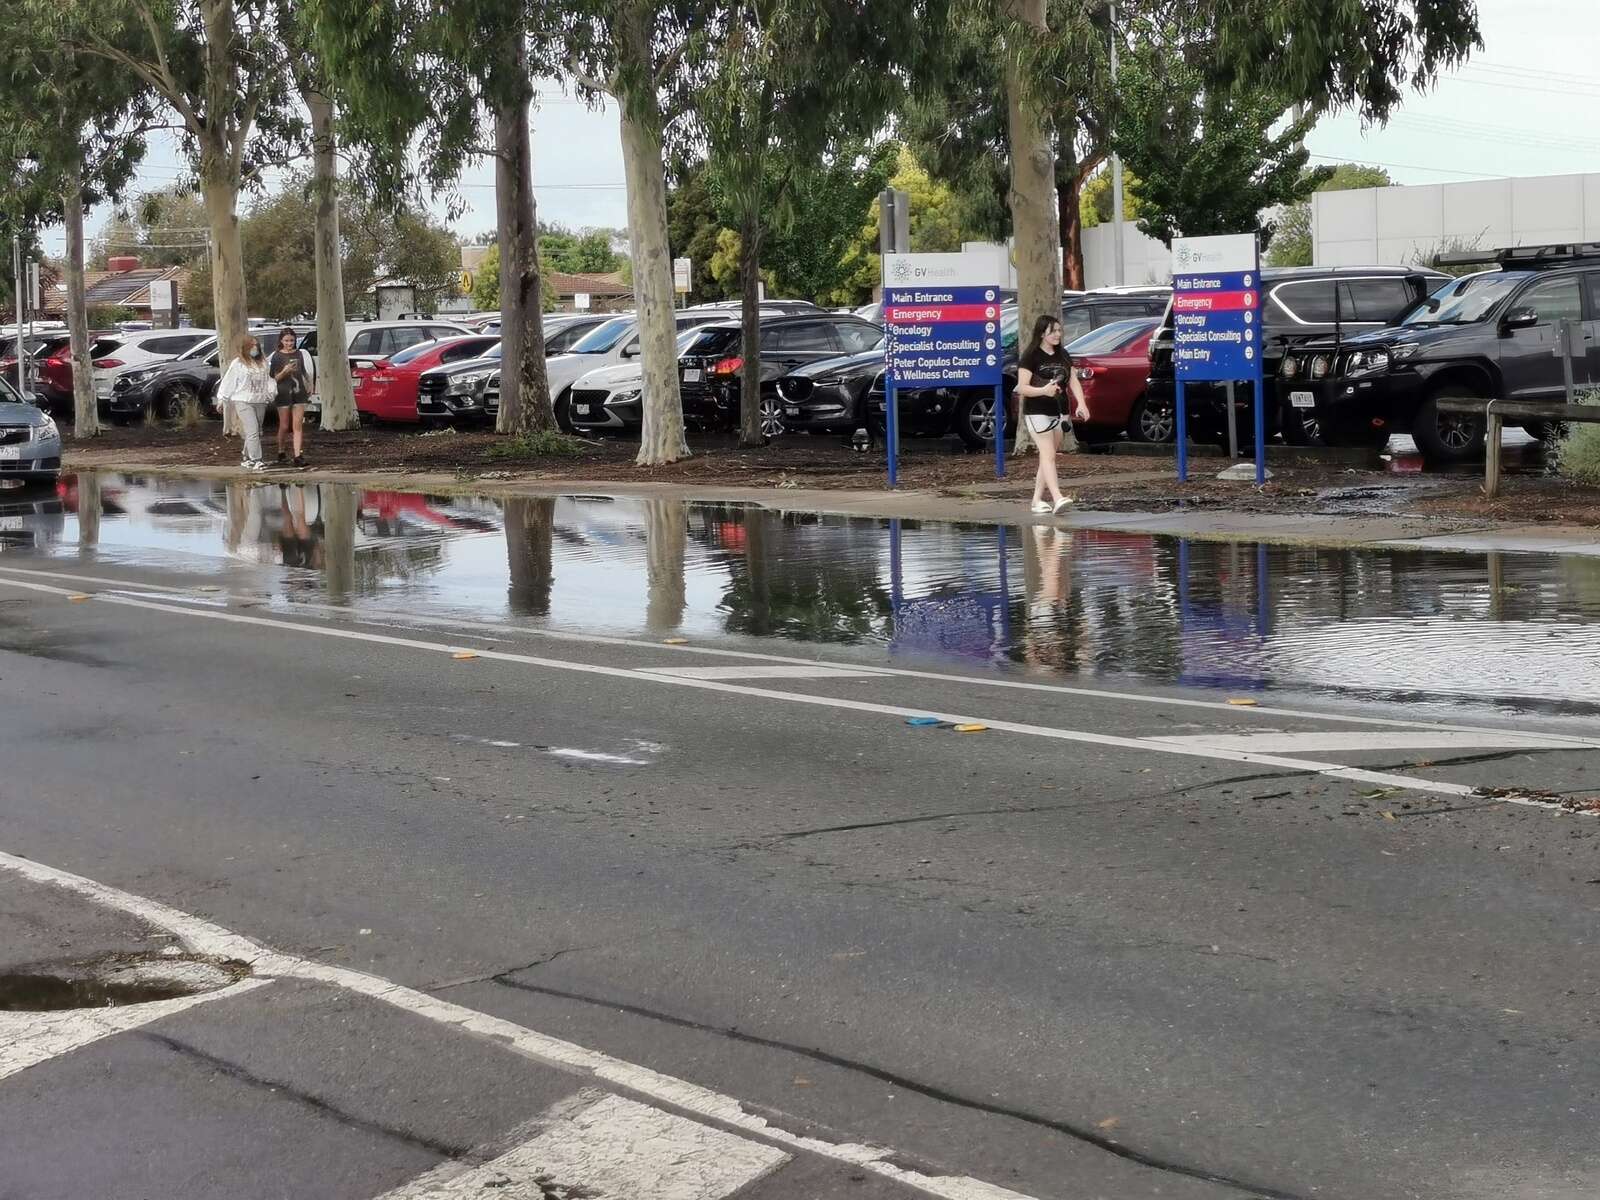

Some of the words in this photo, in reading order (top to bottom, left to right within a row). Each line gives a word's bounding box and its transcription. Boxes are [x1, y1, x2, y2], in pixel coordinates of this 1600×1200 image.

[1177, 279, 1192, 289] Main
[1193, 278, 1221, 288] Entrance
[892, 293, 913, 303] Main
[915, 292, 953, 302] Entrance
[1178, 297, 1212, 309] Emergency
[893, 309, 942, 320] Emergency
[1178, 314, 1206, 326] Oncology
[893, 325, 932, 337] Oncology
[1178, 331, 1207, 344] Specialist
[1208, 330, 1241, 343] Consulting
[893, 341, 934, 353] Specialist
[936, 339, 980, 352] Consulting
[1178, 349, 1193, 359] Main
[1194, 349, 1211, 361] Entry
[894, 358, 916, 367] Peter
[918, 357, 950, 369] Copulos
[952, 357, 981, 366] Cancer
[894, 371, 901, 380] &
[903, 370, 941, 380] Wellness
[942, 369, 970, 379] Centre
